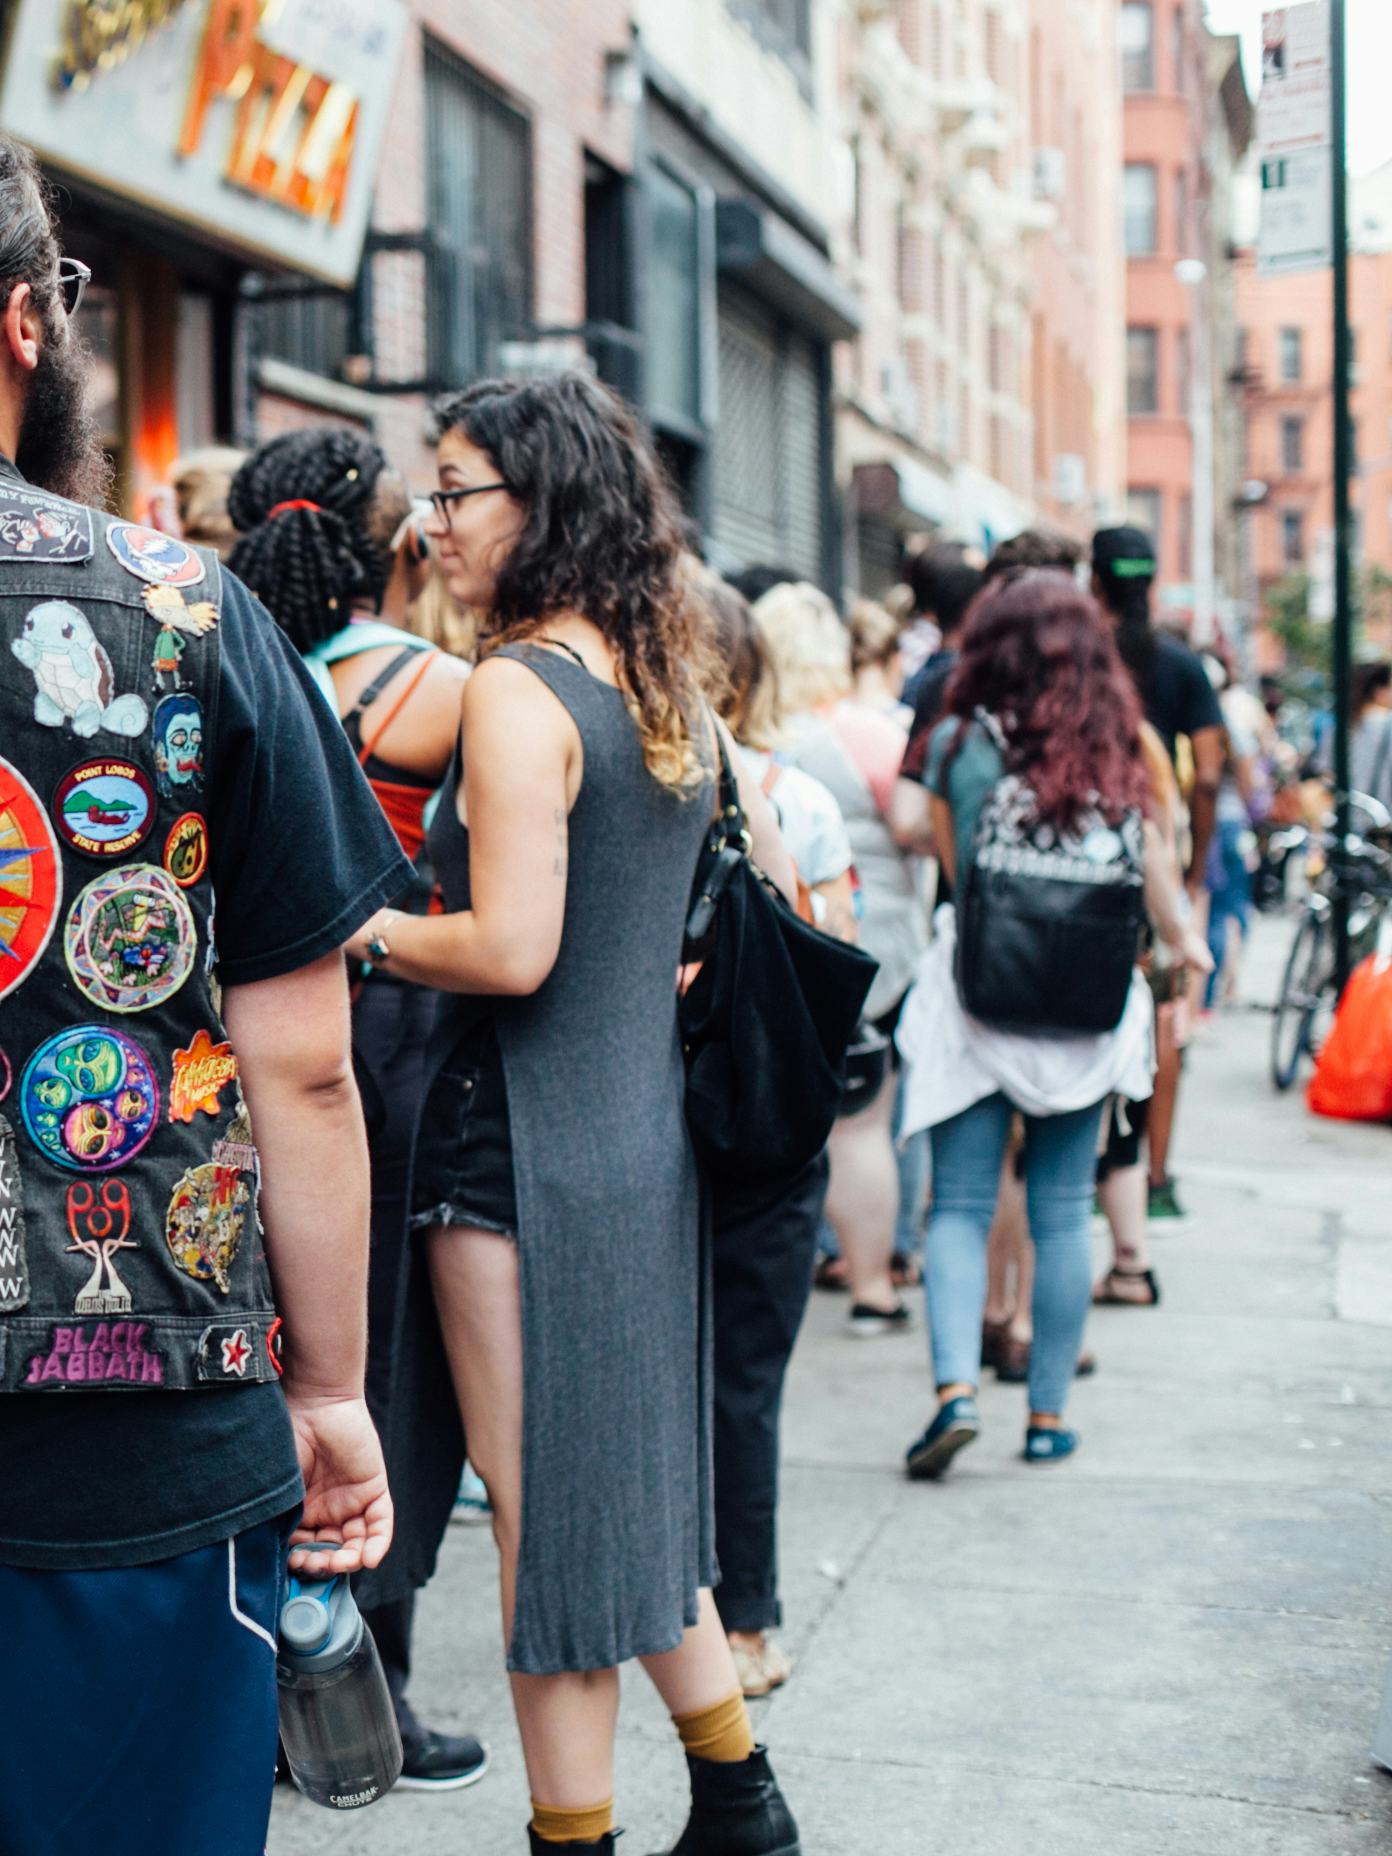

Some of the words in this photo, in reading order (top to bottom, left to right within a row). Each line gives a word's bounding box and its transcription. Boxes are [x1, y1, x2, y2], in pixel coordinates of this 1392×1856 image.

[74, 766, 103, 782] POINT
[105, 765, 136, 779] LOBOS
[72, 832, 99, 852] STATE
[104, 831, 142, 853] RESERVE
[55, 1322, 149, 1353] BLACK
[26, 1351, 163, 1383] SABBATH
